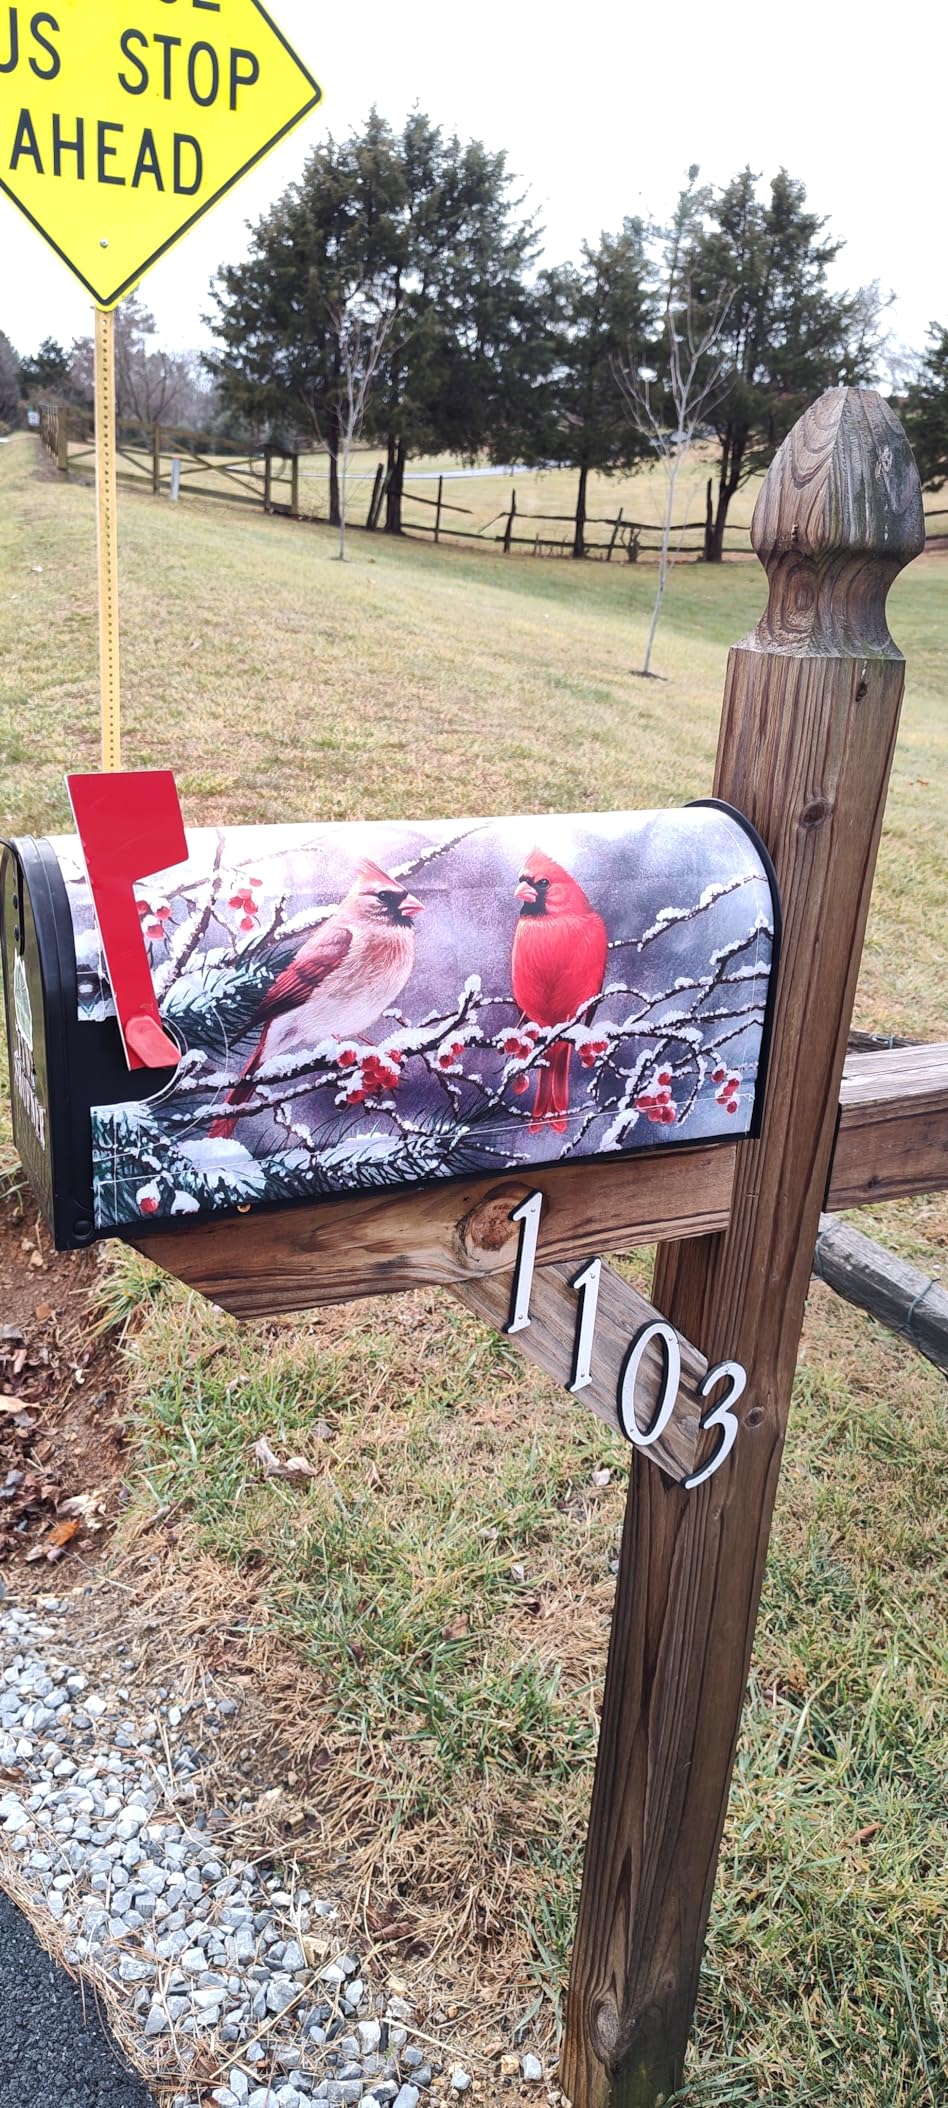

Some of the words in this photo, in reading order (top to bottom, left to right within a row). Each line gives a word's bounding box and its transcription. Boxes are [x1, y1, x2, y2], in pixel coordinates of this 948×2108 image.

[118, 28, 259, 111] STOP
[9, 108, 203, 196] AHEAD
[507, 1191, 747, 1489] 1103
